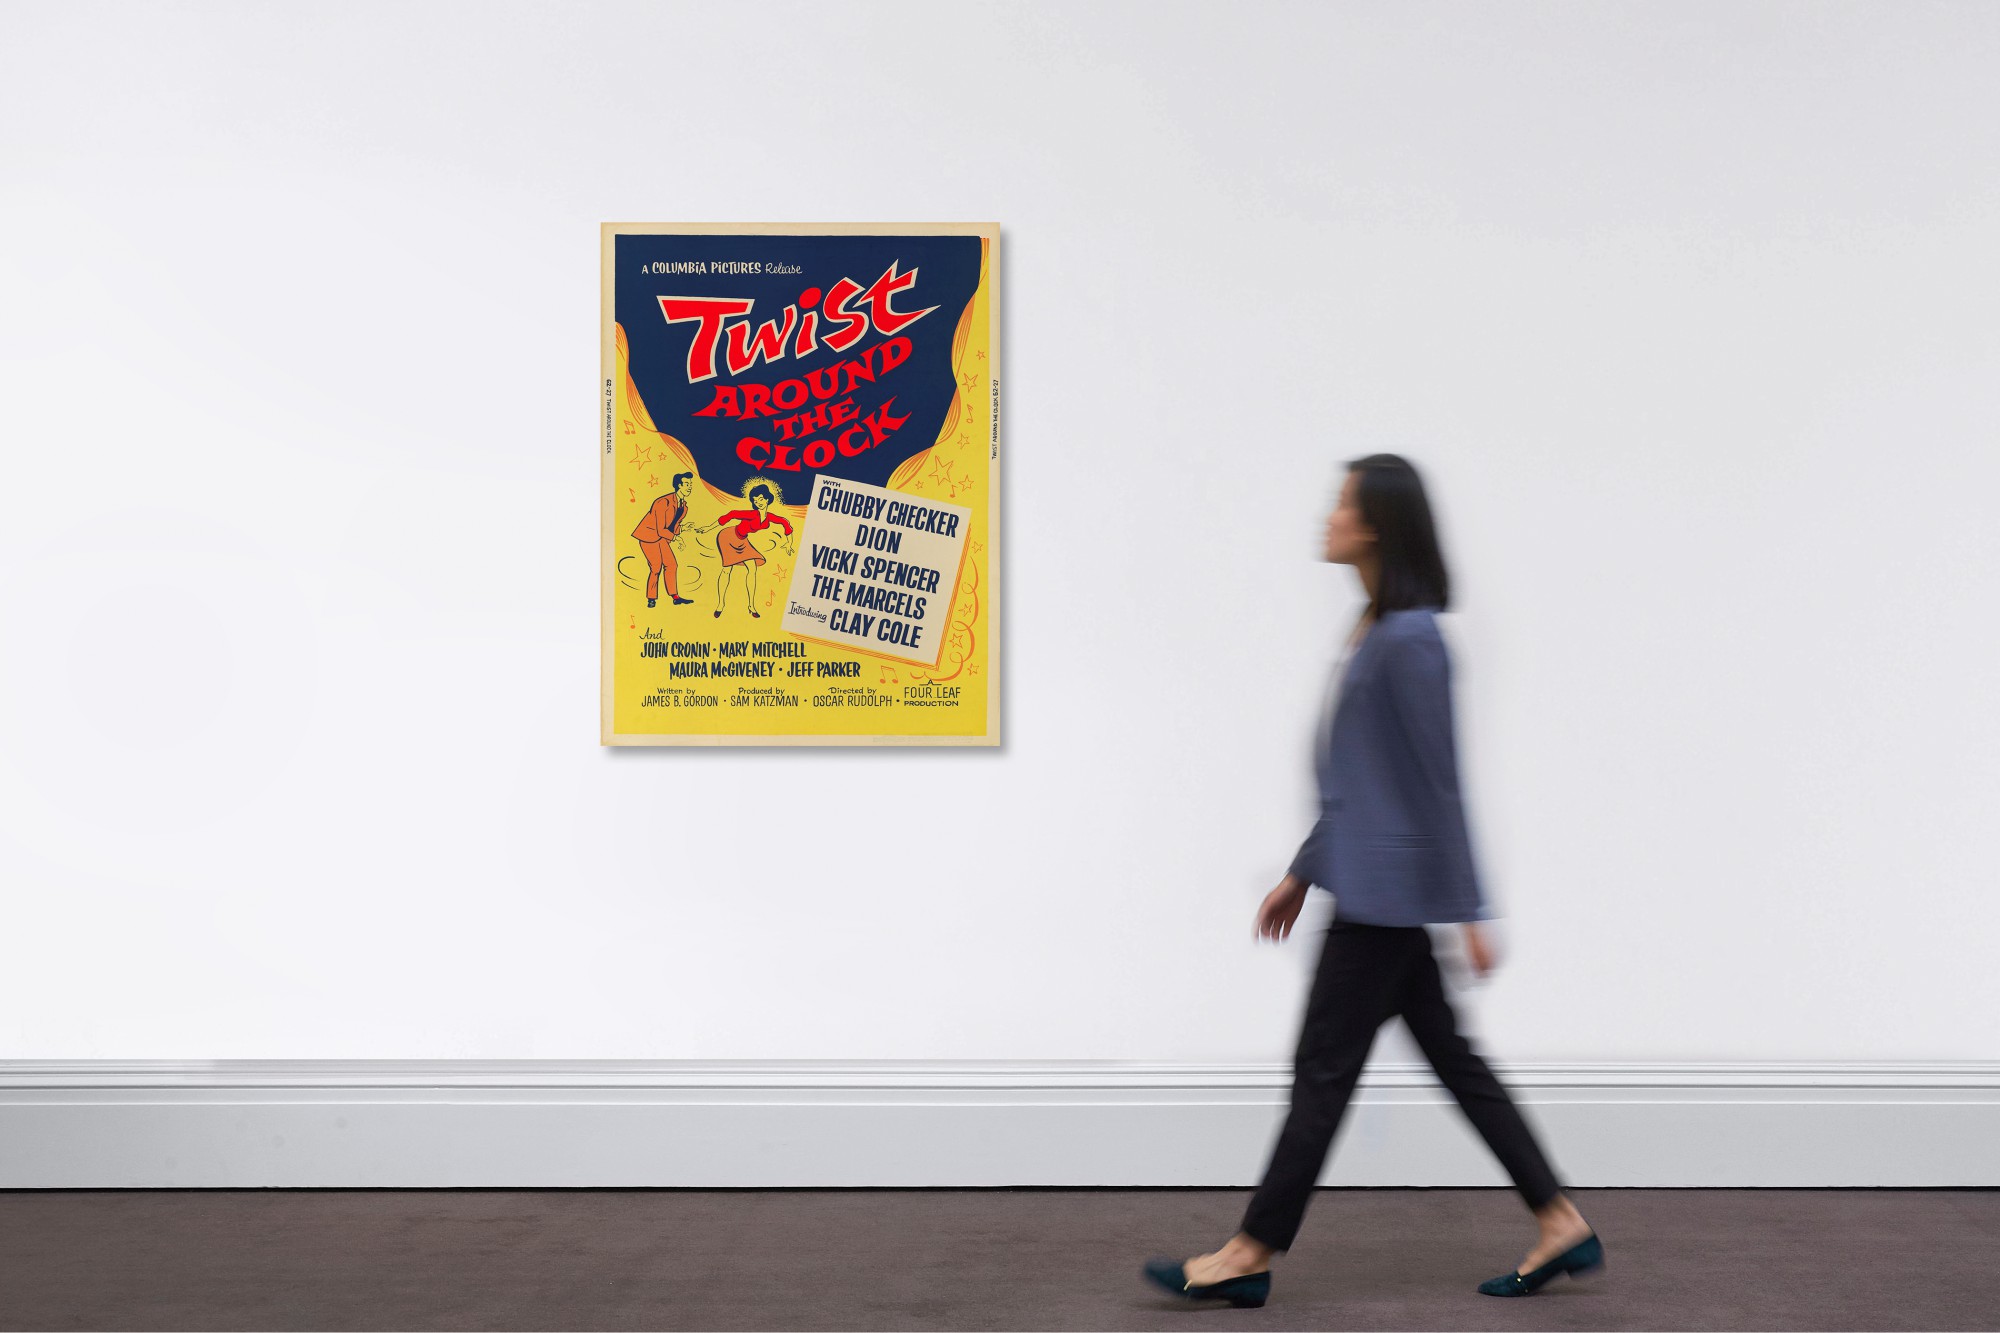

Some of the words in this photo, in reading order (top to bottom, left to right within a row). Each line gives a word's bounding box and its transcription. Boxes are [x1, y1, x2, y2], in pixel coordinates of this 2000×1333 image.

[642, 265, 648, 274] A
[765, 262, 803, 274] Release
[691, 336, 913, 421] AROUND
[774, 396, 862, 442] THE
[735, 395, 912, 472] CLOCK
[817, 486, 886, 521] CHUBBY
[886, 498, 960, 538] CHECKER
[854, 524, 902, 554] DION
[812, 544, 860, 574] VICKI
[861, 557, 941, 594] SPENCER
[811, 574, 844, 601] THE
[846, 582, 927, 620] MARCELS
[639, 628, 665, 640] And
[788, 601, 827, 623] Introducing
[830, 609, 875, 638] CLAY
[876, 621, 923, 649] COLE
[640, 642, 669, 659] JOHN
[671, 642, 710, 659] CRONIN
[718, 641, 750, 659] MARY
[752, 642, 807, 658] MITCHELL
[669, 662, 708, 680] MAURA
[710, 662, 774, 678] McGIVENEY
[787, 662, 815, 678] JEFF
[817, 662, 861, 678] PARKER
[685, 688, 696, 696] by
[775, 688, 785, 696] by
[867, 687, 876, 695] by
[904, 687, 933, 698] FOUR
[936, 687, 961, 698] LEAF
[642, 695, 671, 708] JAMES
[674, 695, 681, 707] B.
[684, 695, 718, 707] GORDON
[730, 695, 750, 707] SAM
[753, 695, 798, 707] KATZMAN
[813, 695, 845, 707] OSCAR
[848, 695, 892, 707] RUDOLPH
